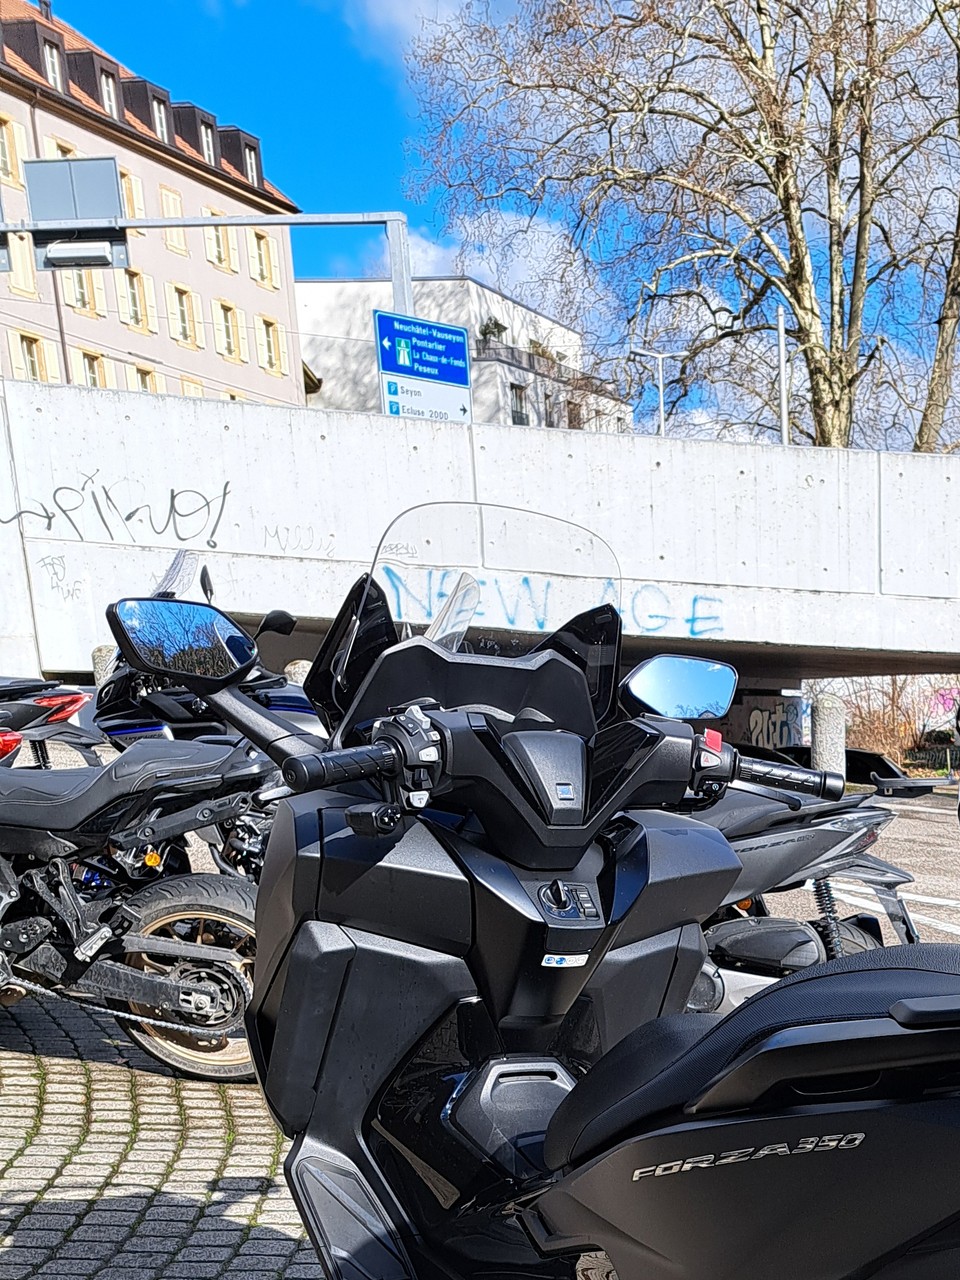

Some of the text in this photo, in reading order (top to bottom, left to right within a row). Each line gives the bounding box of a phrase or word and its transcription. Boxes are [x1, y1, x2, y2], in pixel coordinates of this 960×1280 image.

[393, 320, 464, 344] Neuchâtel-Vauseyon
[411, 336, 447, 352] Pontarlier
[413, 350, 420, 359] La
[413, 362, 439, 376] Peseux
[400, 386, 422, 398] Seyon
[428, 409, 449, 421] 2000
